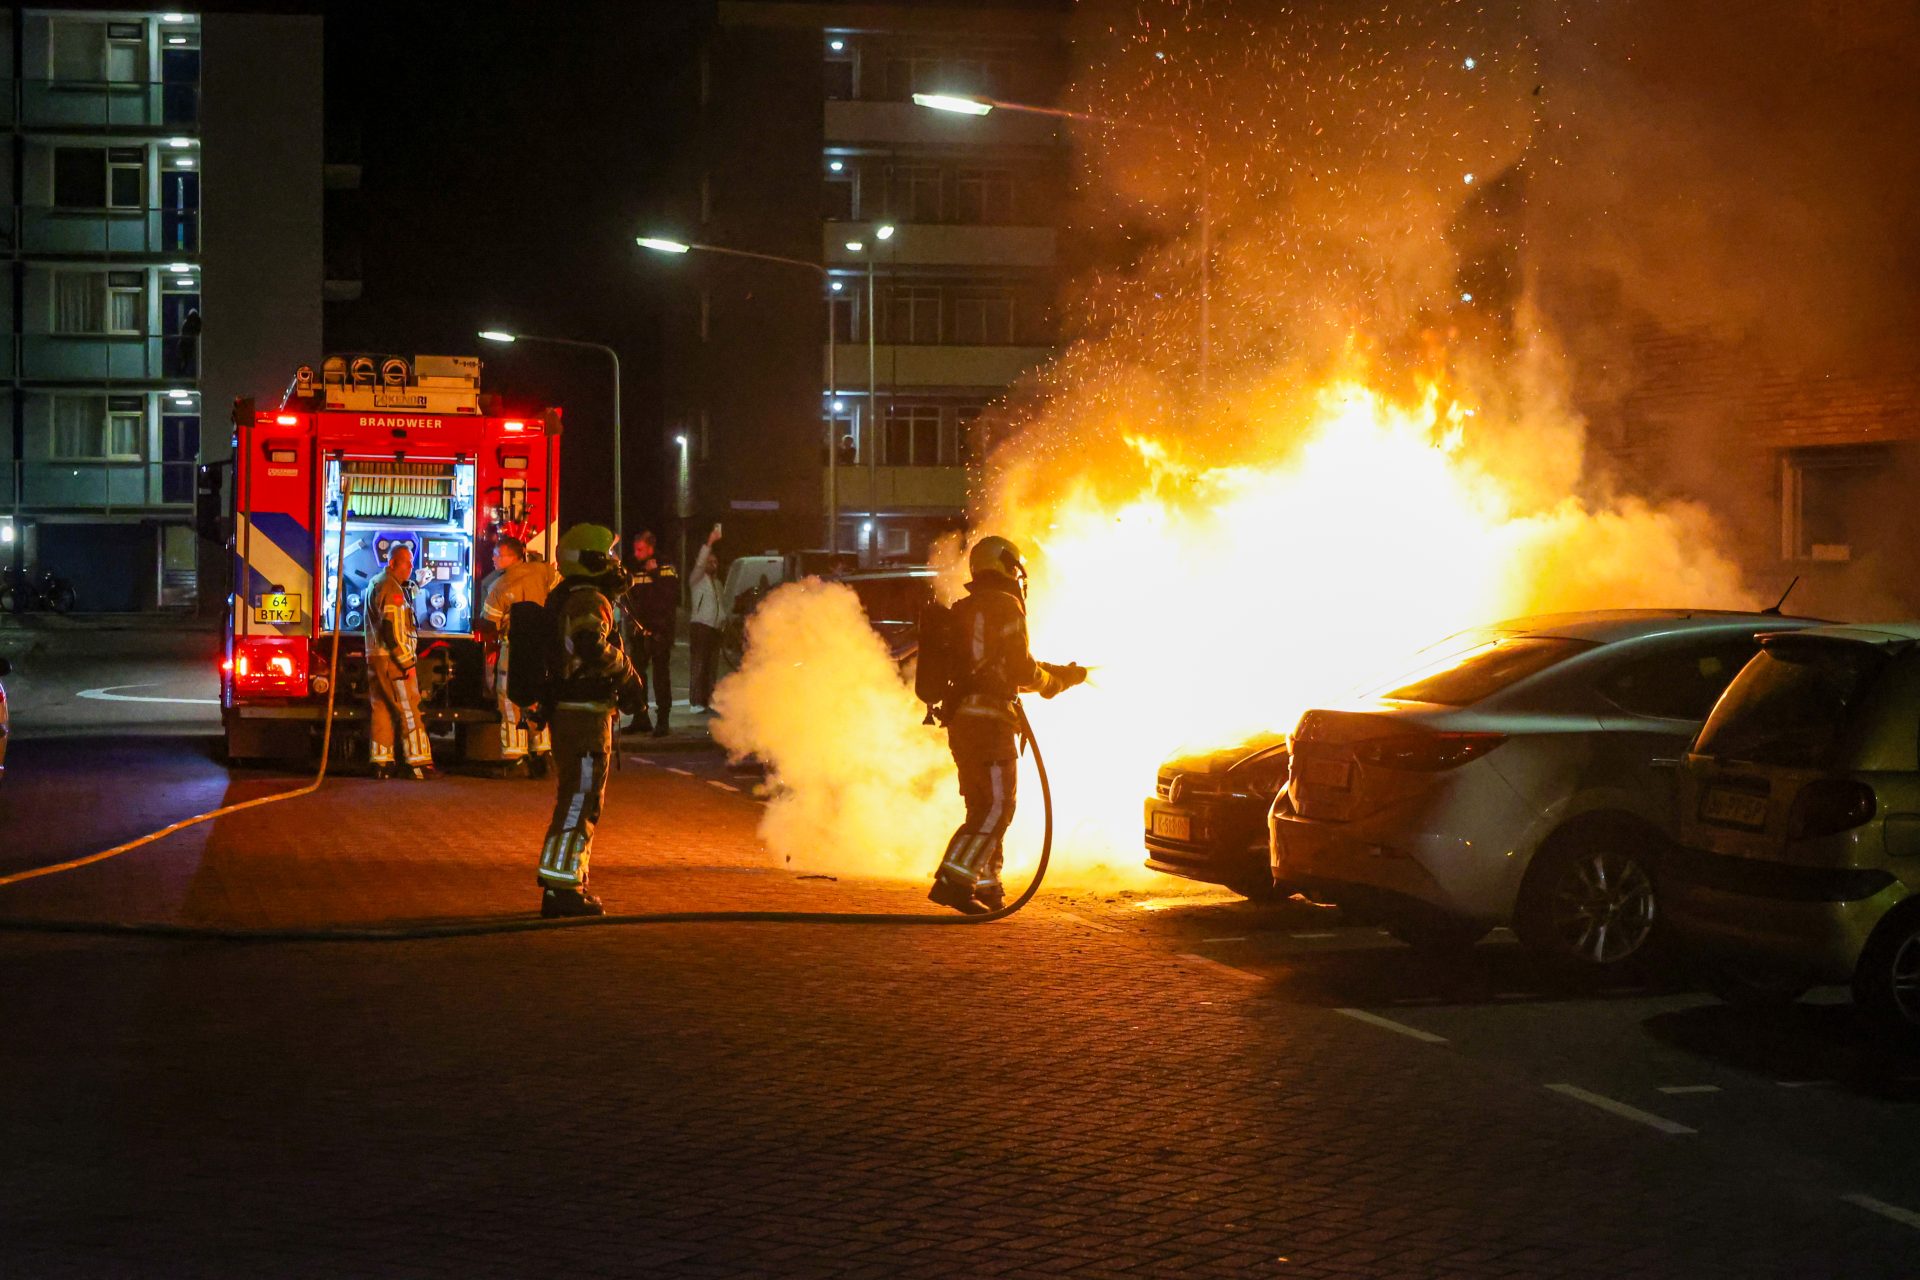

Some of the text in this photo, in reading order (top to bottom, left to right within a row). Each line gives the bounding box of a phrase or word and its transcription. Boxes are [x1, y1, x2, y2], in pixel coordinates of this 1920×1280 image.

[360, 417, 442, 428] BRANDWEER
[272, 596, 288, 607] 64
[260, 609, 296, 621] BTK-7
